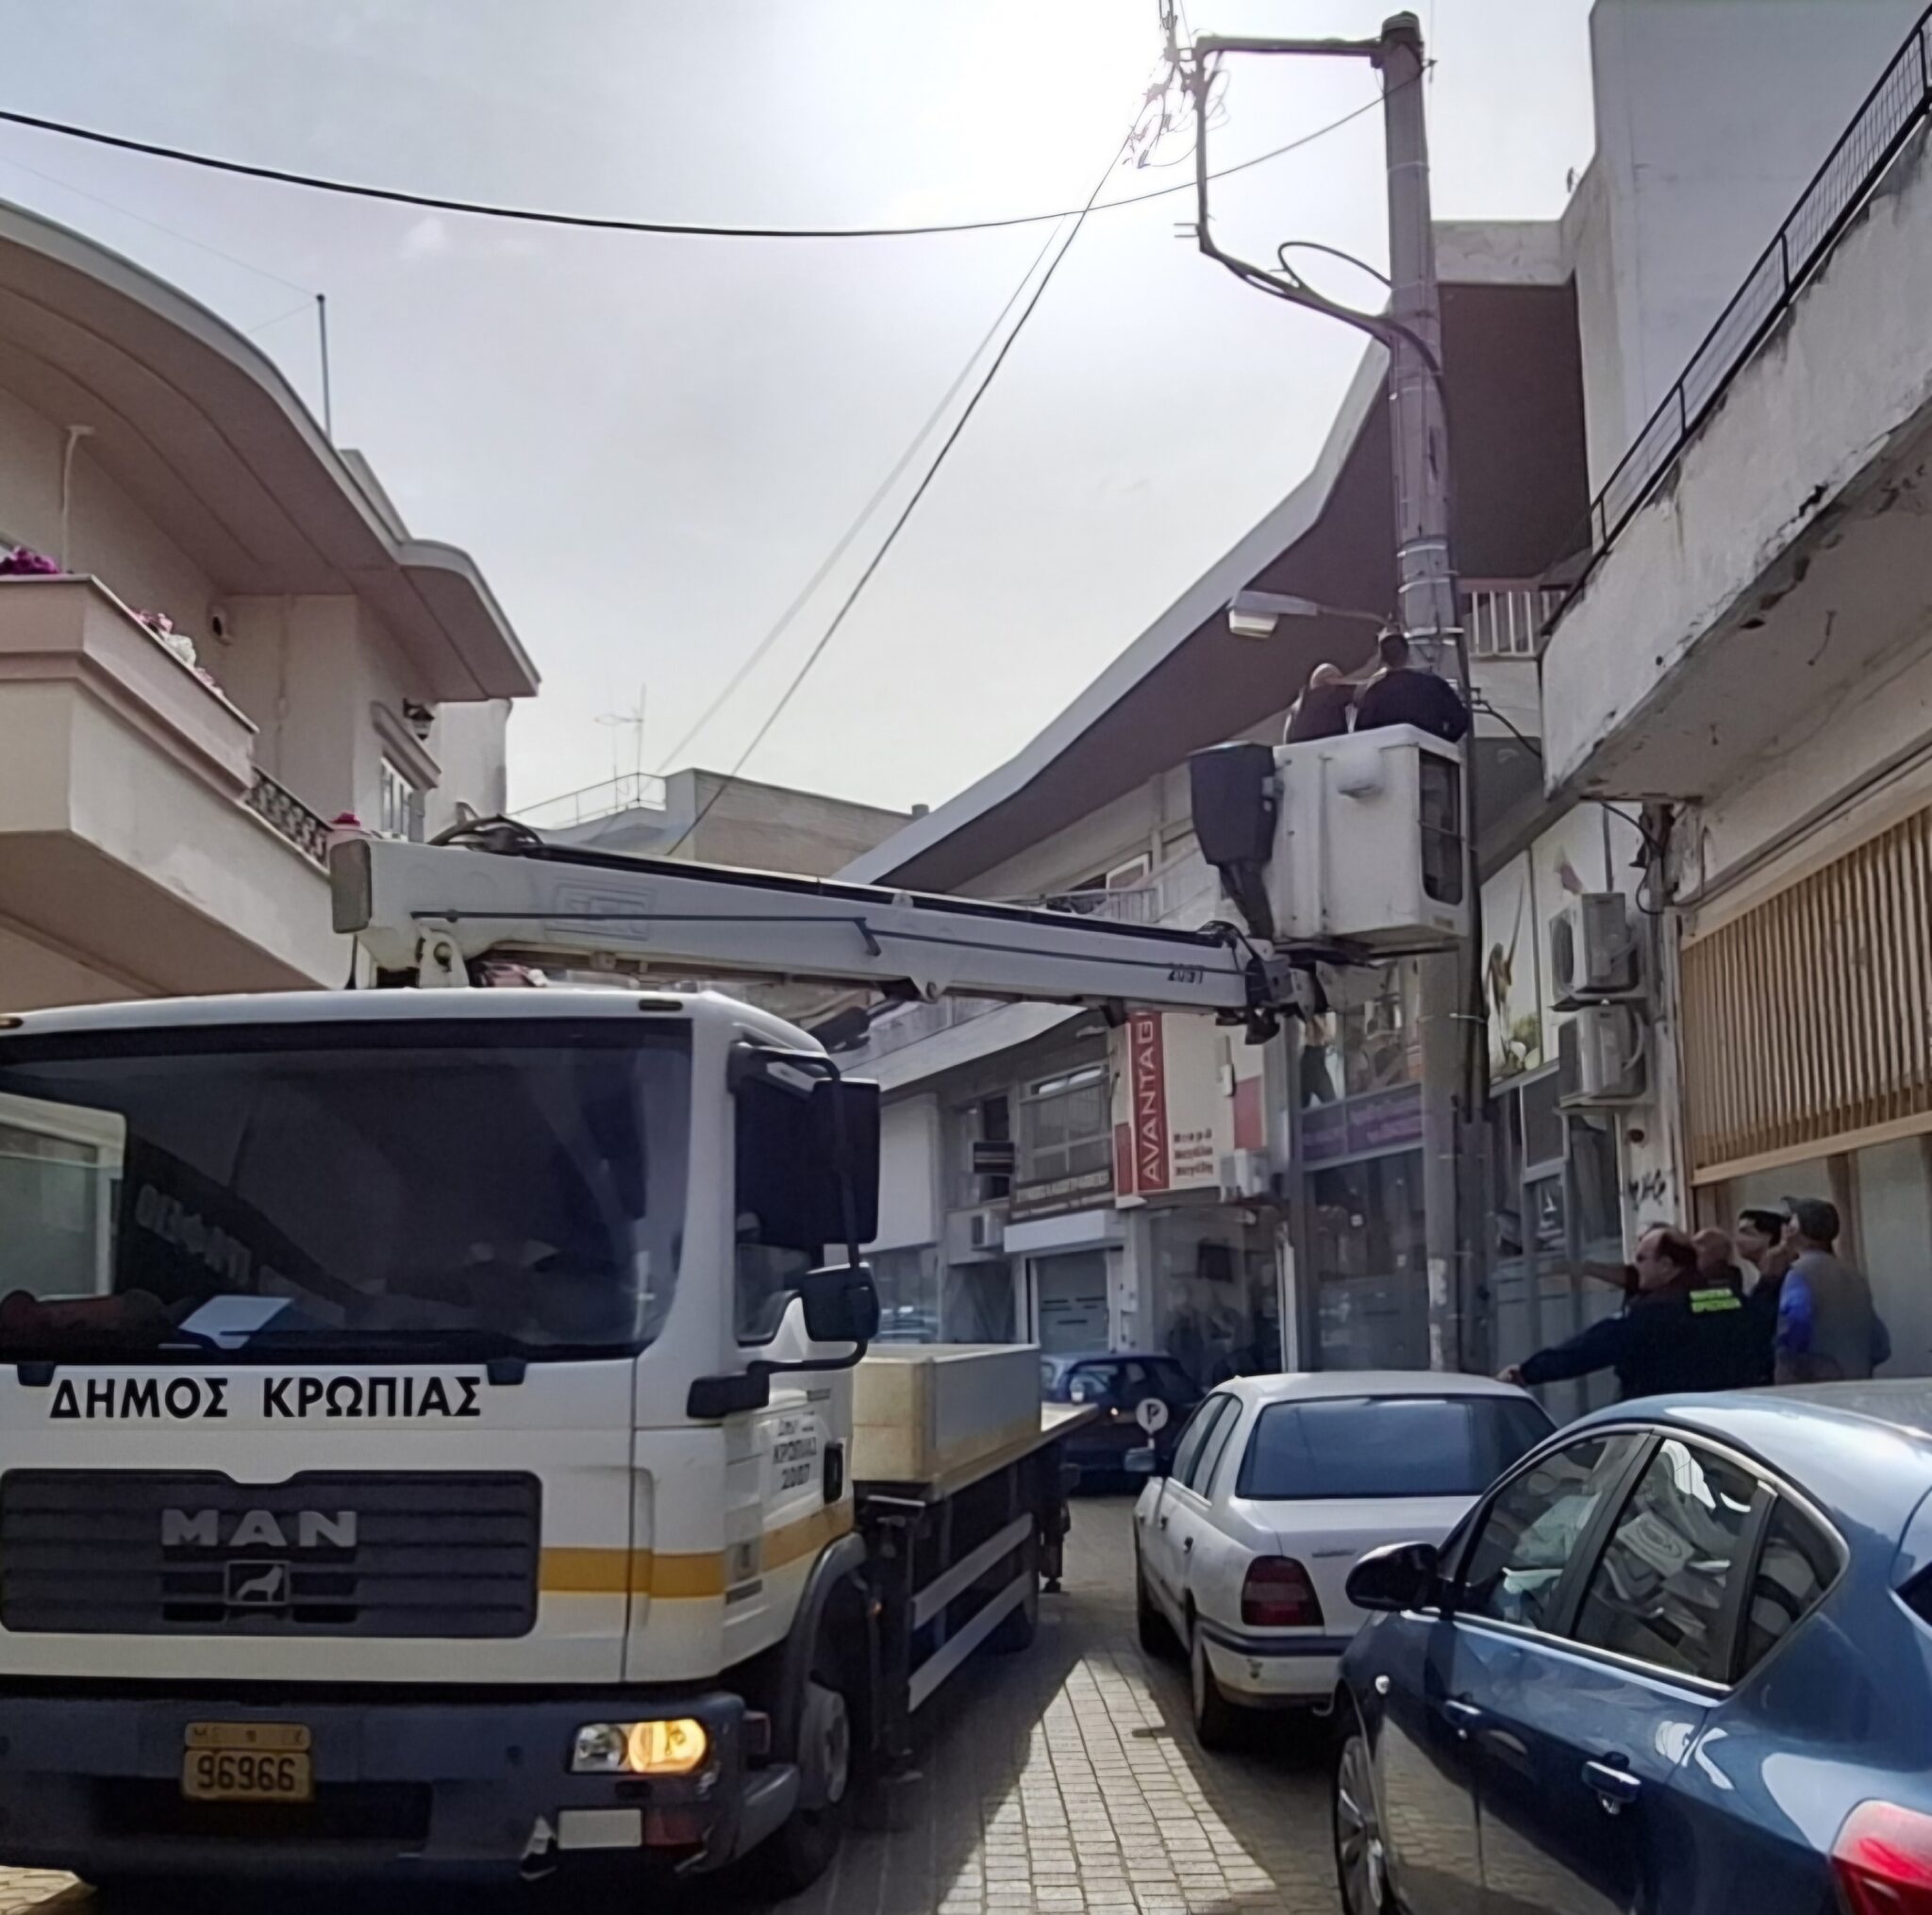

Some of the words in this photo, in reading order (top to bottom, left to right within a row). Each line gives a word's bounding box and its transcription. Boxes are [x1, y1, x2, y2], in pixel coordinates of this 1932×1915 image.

[1135, 1011, 1161, 1183] AVANTAG
[49, 1377, 229, 1418] ΔΗΜΟΣ
[262, 1376, 482, 1417] ΚΡΩΠΙΑΣ
[1146, 1403, 1161, 1425] P
[161, 1509, 358, 1547] MAN
[196, 1754, 296, 1791] 96966
